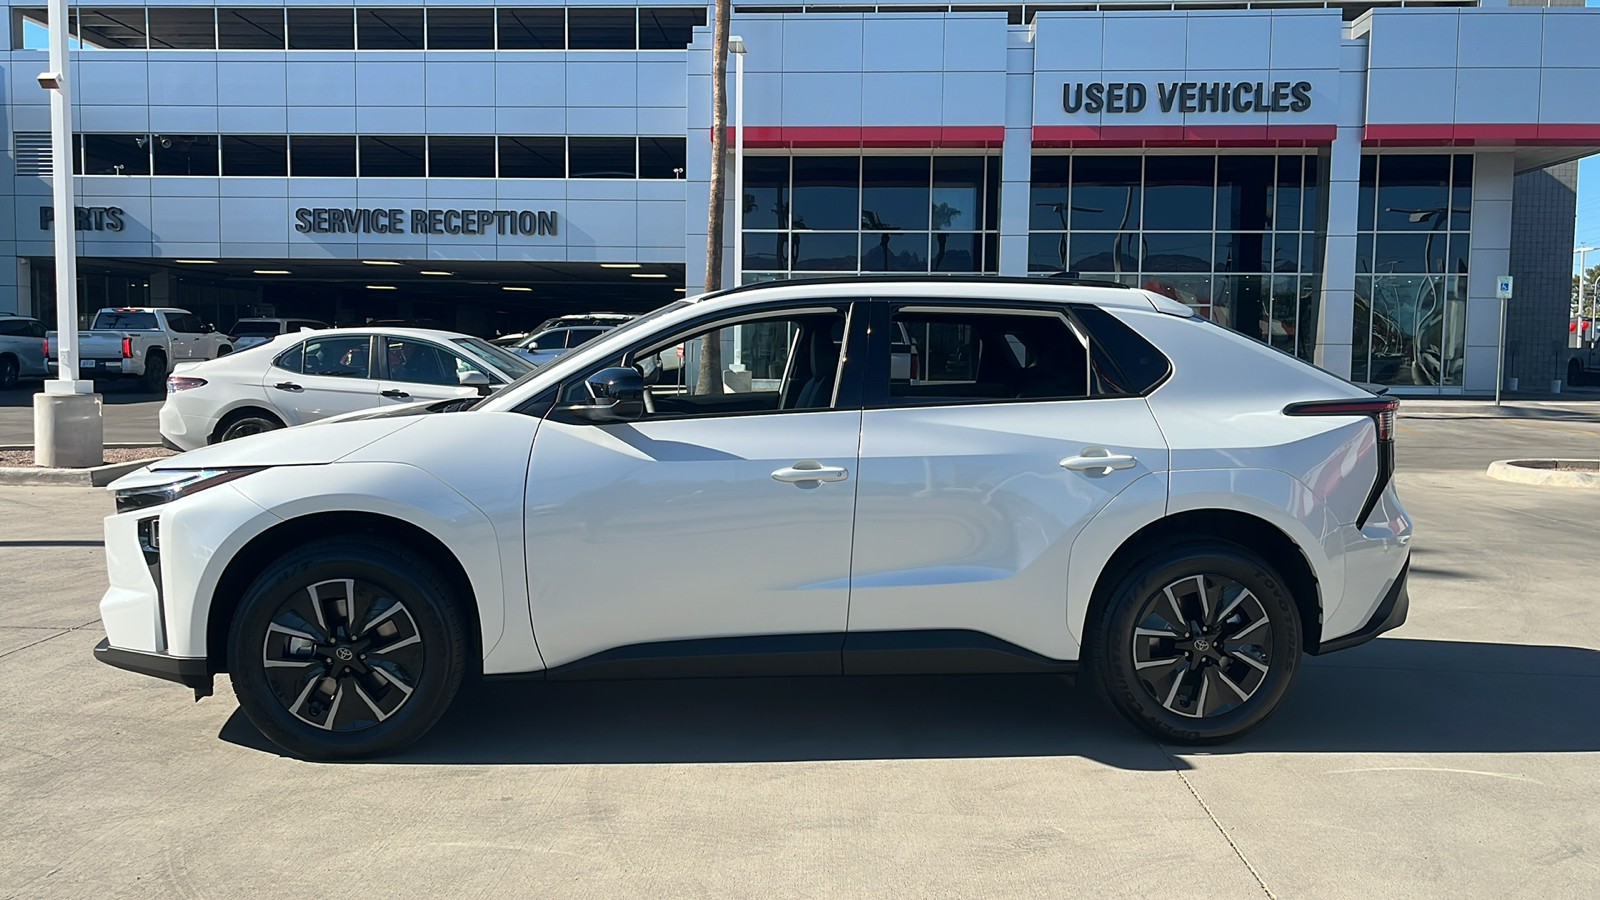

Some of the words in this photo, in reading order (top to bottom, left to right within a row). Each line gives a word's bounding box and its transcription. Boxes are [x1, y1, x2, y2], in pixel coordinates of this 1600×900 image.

[1062, 83, 1147, 113] USED
[1157, 81, 1312, 113] VEHICLES
[40, 206, 124, 231] PRTS
[295, 208, 404, 234] SERVICE
[410, 209, 558, 236] RECEPTION
